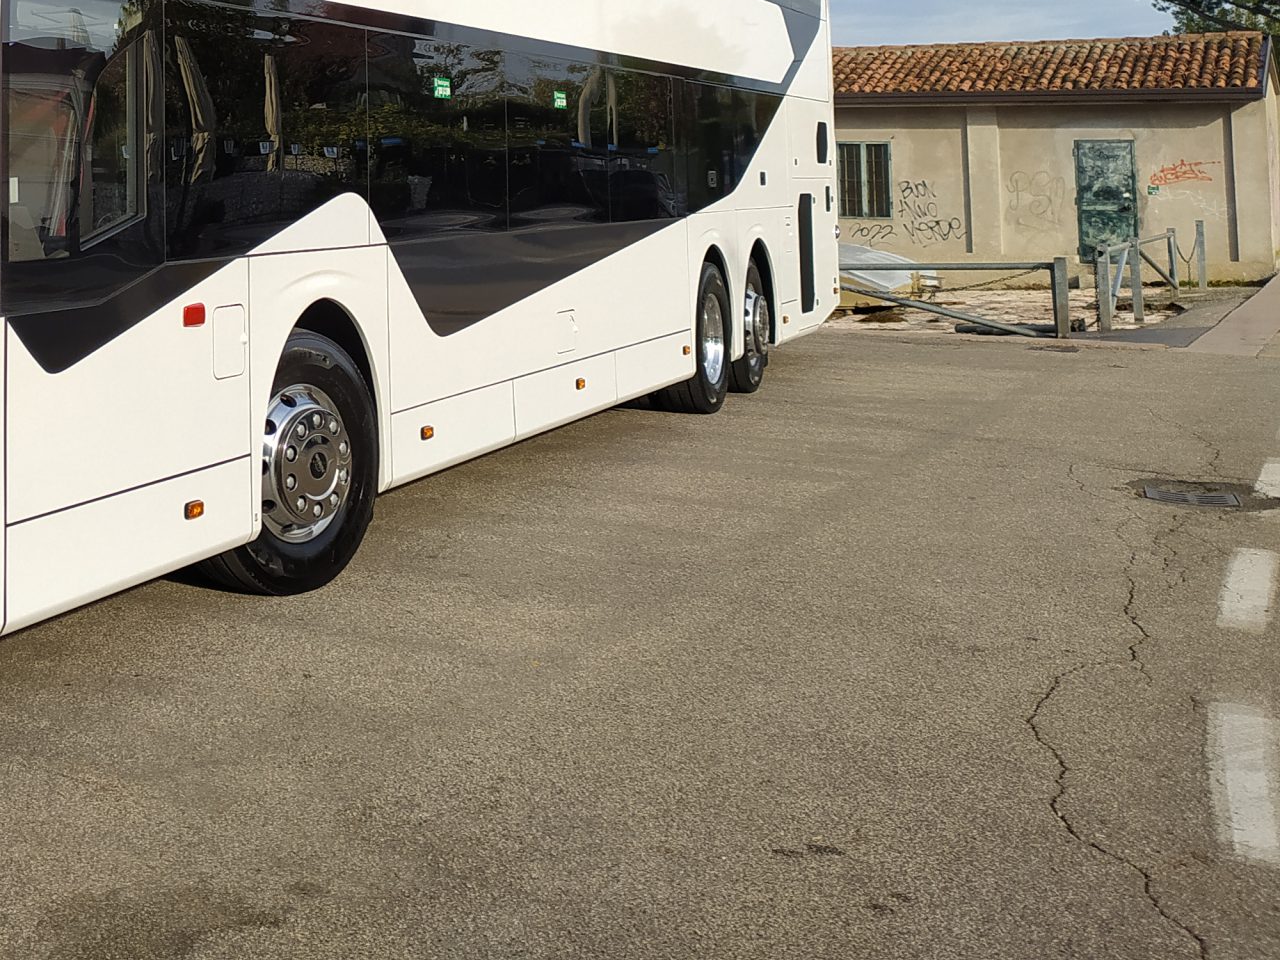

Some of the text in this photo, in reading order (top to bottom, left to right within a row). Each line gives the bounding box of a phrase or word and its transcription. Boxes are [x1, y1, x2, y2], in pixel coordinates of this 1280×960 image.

[898, 180, 937, 200] BUON
[898, 199, 938, 220] ANNO
[849, 222, 898, 239] 2022
